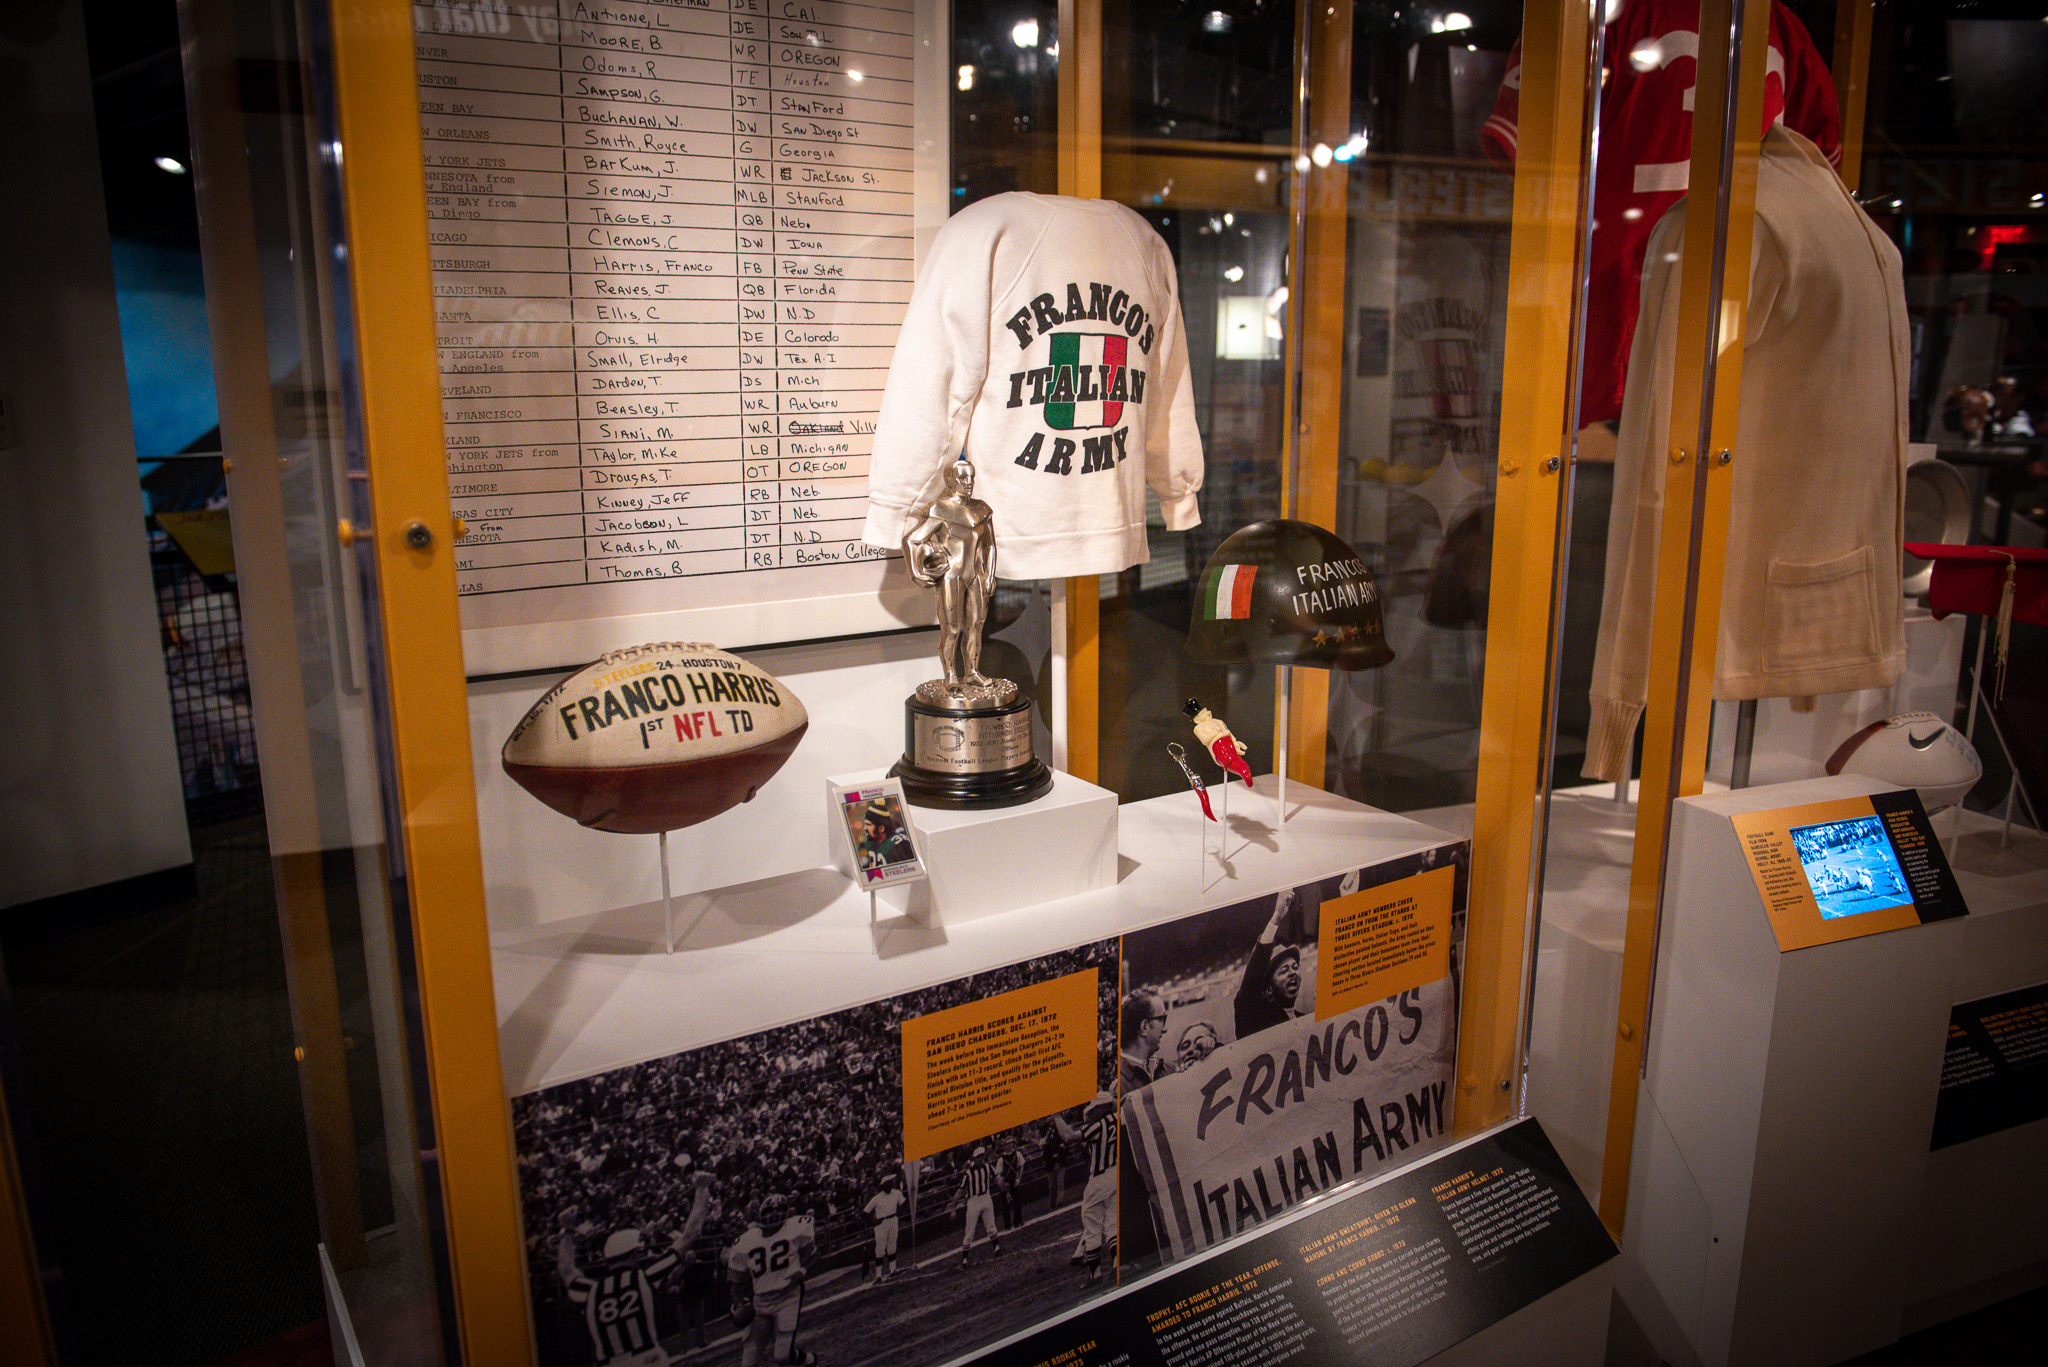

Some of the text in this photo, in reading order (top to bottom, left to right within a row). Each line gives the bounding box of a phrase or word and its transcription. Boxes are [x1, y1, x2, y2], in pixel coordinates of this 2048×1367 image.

[581, 30, 664, 52] MOORE, B.
[734, 45, 756, 59] WR
[781, 50, 840, 67] OREGON
[582, 56, 656, 78] Odoms, R
[736, 70, 757, 85] TE
[785, 73, 830, 87] Houston
[437, 128, 490, 140] ORLEANS
[584, 130, 688, 153] Smith, Royce
[740, 141, 752, 154] G
[439, 156, 506, 167] YORK JETS
[663, 161, 678, 174] J.
[740, 166, 766, 179] WR
[862, 170, 880, 183] St.
[441, 184, 493, 193] England
[667, 235, 678, 250] C
[741, 238, 763, 249] DW
[432, 260, 490, 269] TTSBURGH
[744, 262, 762, 274] FB
[655, 284, 670, 295] J.
[743, 284, 765, 296] QB
[647, 307, 659, 319] C
[744, 308, 765, 320] DW
[1005, 282, 1155, 355] FRANCO'S
[452, 350, 539, 359] ENGLAND from
[1006, 364, 1146, 409] ITALIAN
[665, 401, 679, 413] T.
[744, 398, 769, 410] WR
[456, 410, 522, 420] FRANCISCO
[751, 444, 769, 456] LB
[1014, 426, 1128, 476] ARMY
[751, 489, 769, 501] RB
[485, 508, 513, 517] CITY
[845, 541, 886, 560] College
[754, 552, 772, 567] RB
[672, 561, 683, 575] B
[1292, 583, 1358, 616] ITALIAN
[593, 661, 656, 690] STEELERS
[656, 660, 674, 671] 24
[683, 658, 734, 670] HOUSTON
[560, 672, 781, 741] FRANCO HARRIS
[673, 711, 722, 742] NFL
[726, 709, 753, 734] TD
[884, 867, 916, 877] STEELERS
[1335, 914, 1356, 925] ITALIAN
[1358, 909, 1371, 918] ARMY
[1373, 902, 1396, 914] MEMBERS
[1335, 923, 1355, 934] FRANCO
[1365, 916, 1378, 924] FROM
[1380, 912, 1389, 920] THE
[1391, 906, 1410, 917] STANDS
[1335, 934, 1350, 942] THREE
[1352, 927, 1370, 937] RIVERS
[926, 1006, 1047, 1047] FRANCO HARRIS SCORES AGAINST
[926, 1048, 942, 1057] SAN
[945, 1040, 965, 1052] DIEGO
[1010, 1024, 1025, 1032] DEC.
[1041, 1013, 1057, 1023] 1972
[940, 1056, 954, 1065] week
[956, 1050, 974, 1060] before
[987, 1038, 1019, 1051] Immaculate
[1050, 1024, 1059, 1032] the
[1197, 987, 1423, 1141] FRANCO'S
[1193, 1080, 1447, 1247] ITALIAN ARMY
[1431, 1181, 1451, 1194] FRANCO
[1436, 1189, 1457, 1202] ITALIAN
[1457, 1182, 1471, 1194] ARMY
[1491, 1167, 1504, 1177] 1972
[1299, 1238, 1322, 1255] ITALIAN
[1323, 1231, 1339, 1243] ARMY
[1374, 1209, 1391, 1221] GIVEN
[1390, 1205, 1399, 1213] TO
[1399, 1197, 1416, 1210] GLENN
[748, 1239, 790, 1278] 32
[1175, 1299, 1188, 1311] AFC
[1188, 1290, 1212, 1304] ROOKIE
[1212, 1286, 1220, 1294] OF
[1221, 1279, 1234, 1289] THE
[599, 1290, 640, 1323] 82
[1152, 1315, 1181, 1333] AWARDED
[1182, 1311, 1191, 1319] TO
[1192, 1299, 1217, 1314] FRANCO
[1243, 1279, 1258, 1292] 1972
[1051, 1340, 1097, 1366] ROOKIE YEAR
